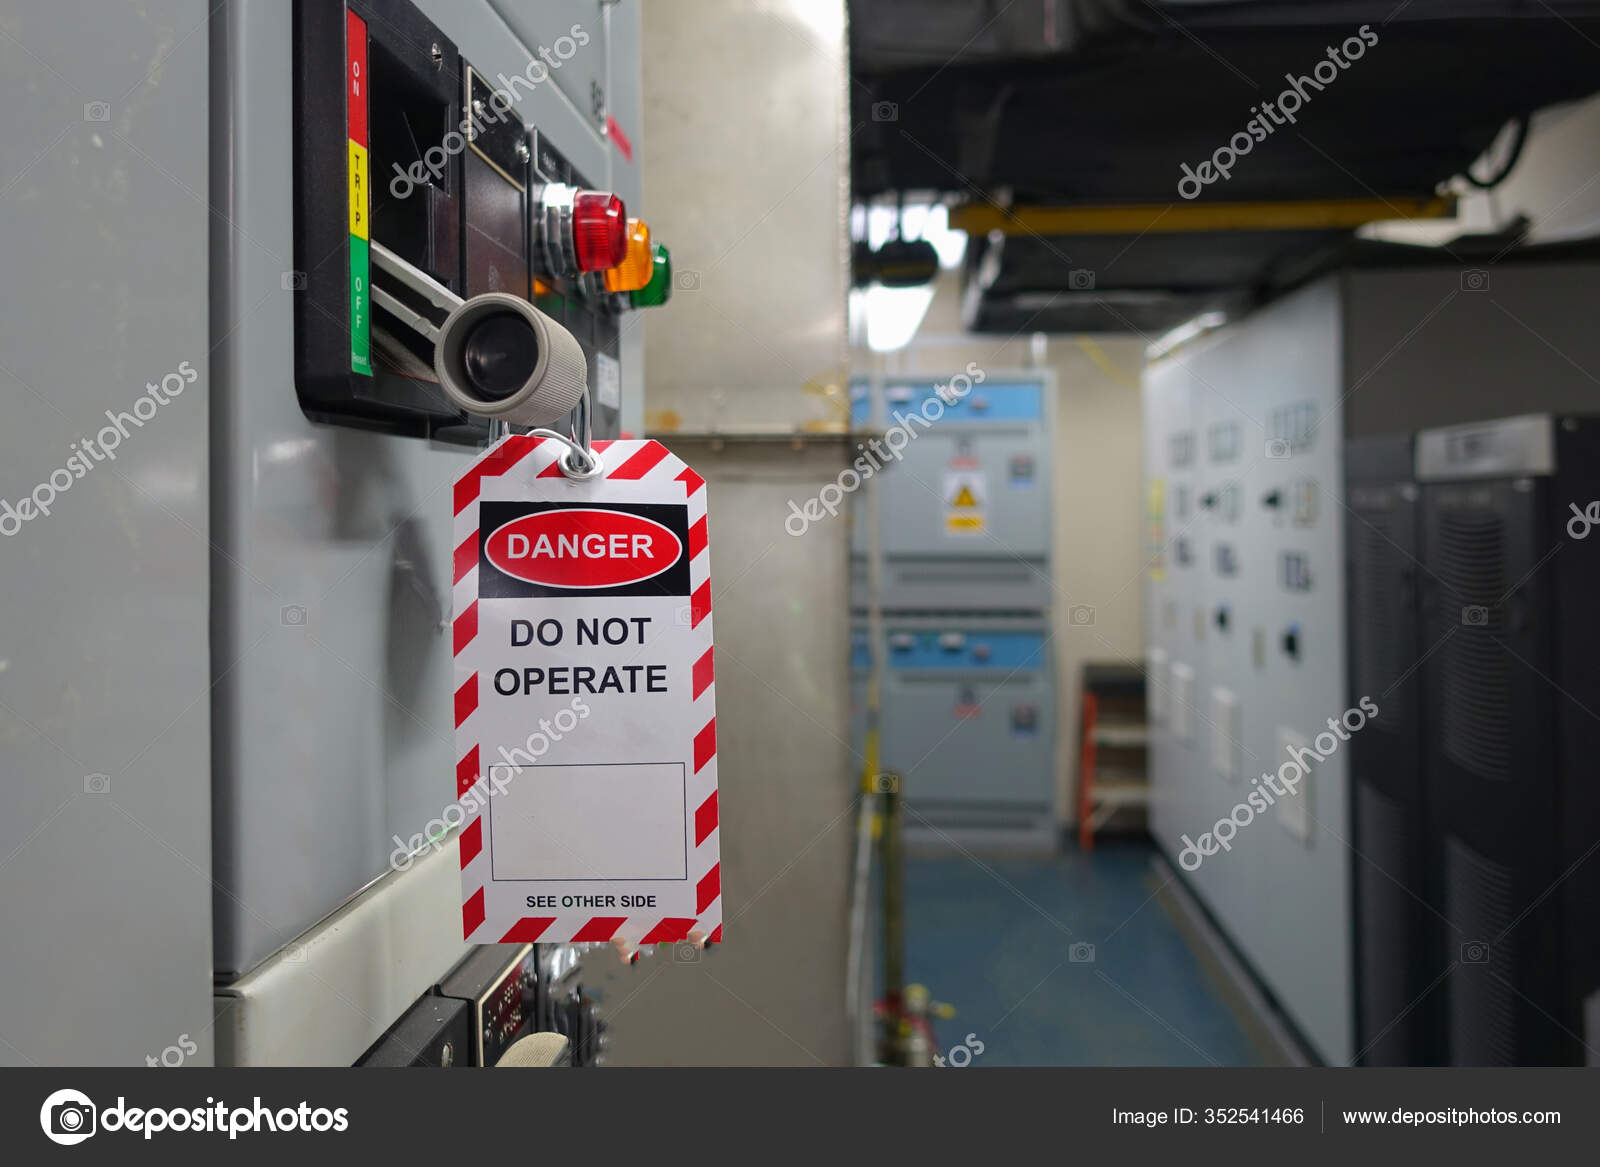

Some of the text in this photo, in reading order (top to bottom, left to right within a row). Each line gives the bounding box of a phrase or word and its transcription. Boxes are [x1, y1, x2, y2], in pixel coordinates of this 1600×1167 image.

[352, 61, 360, 97] ON
[507, 533, 654, 560] DANGER
[510, 617, 652, 647] DO NOT
[493, 665, 668, 697] OPERATE
[526, 895, 657, 909] SEE OTHER SIDE
